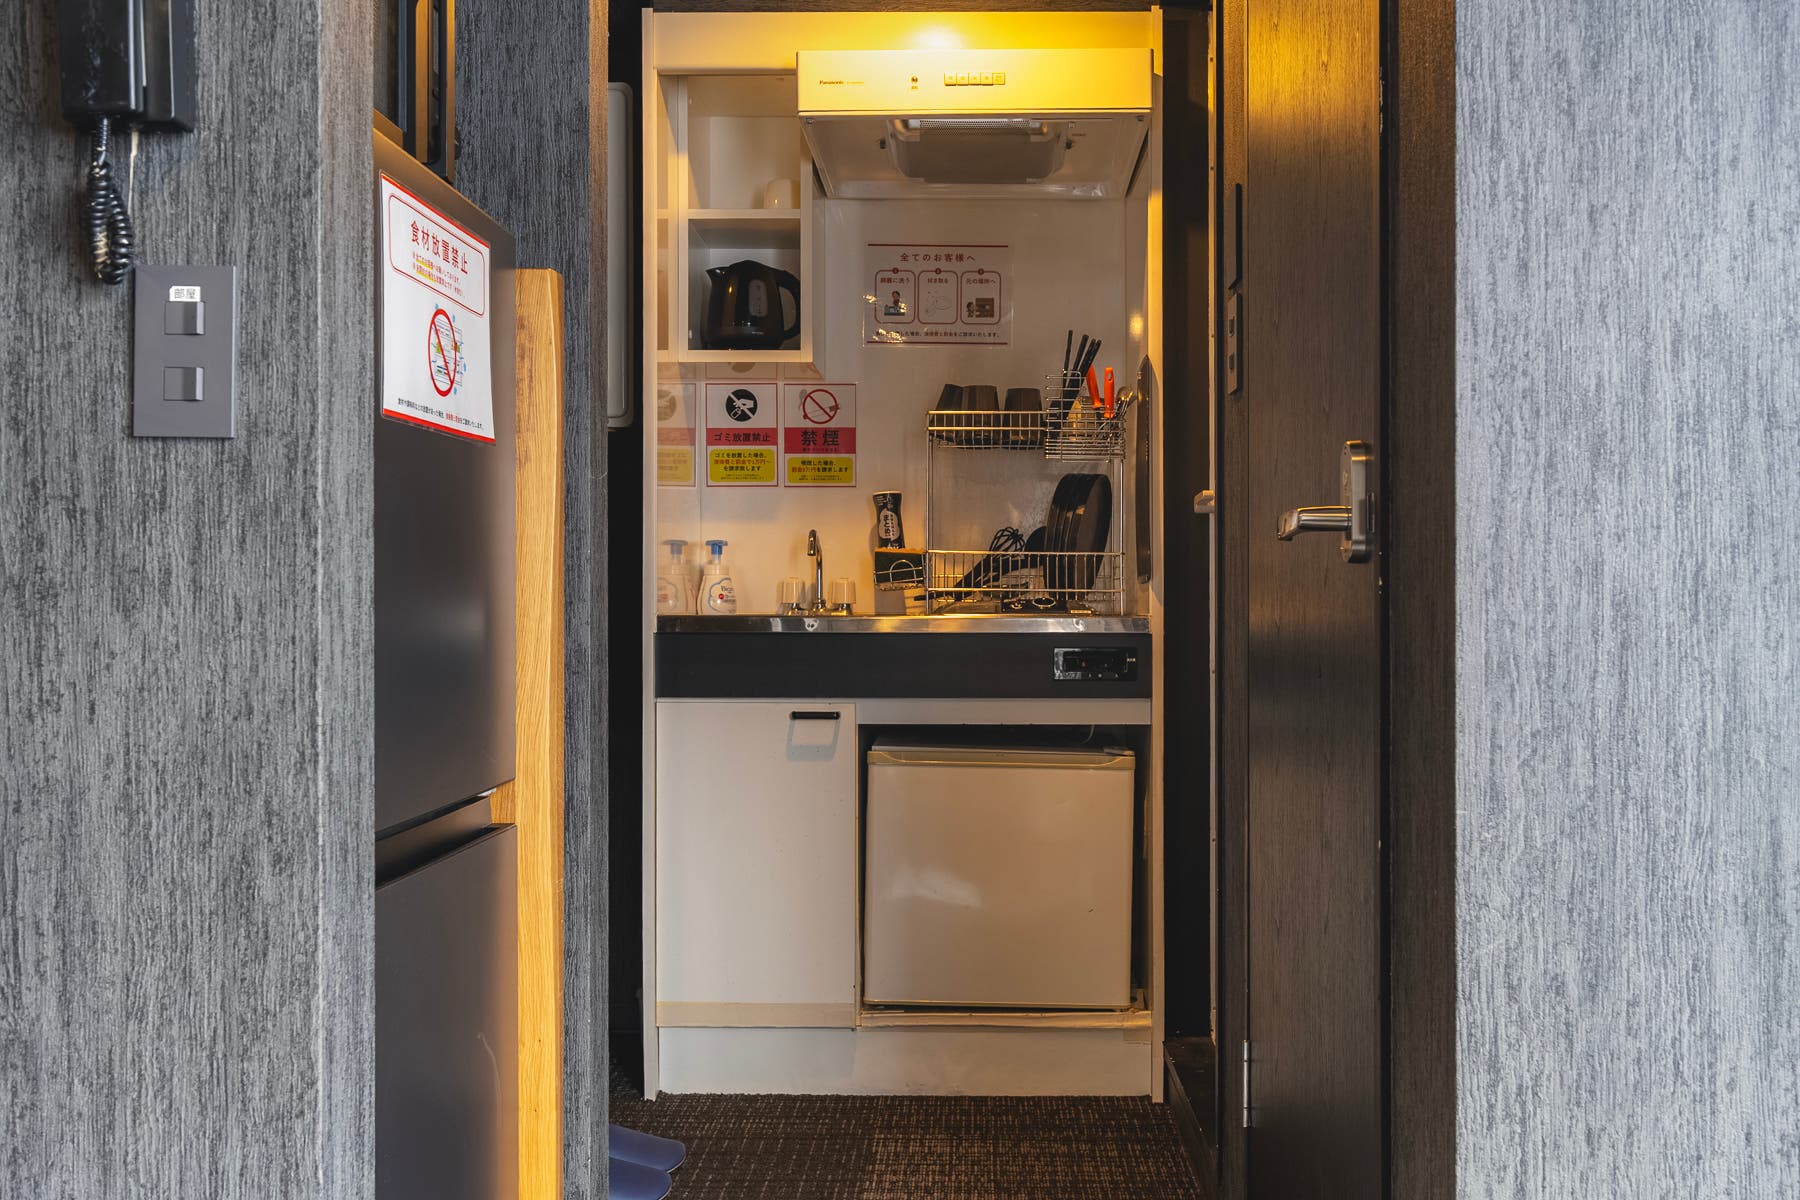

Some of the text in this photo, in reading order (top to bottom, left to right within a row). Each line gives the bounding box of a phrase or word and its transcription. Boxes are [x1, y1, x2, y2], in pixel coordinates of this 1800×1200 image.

[411, 220, 468, 274] 食材放置禁止
[900, 252, 975, 262] 全てのお客様へ
[714, 432, 771, 442] ゴミ放置禁止
[801, 430, 840, 446] 禁煙
